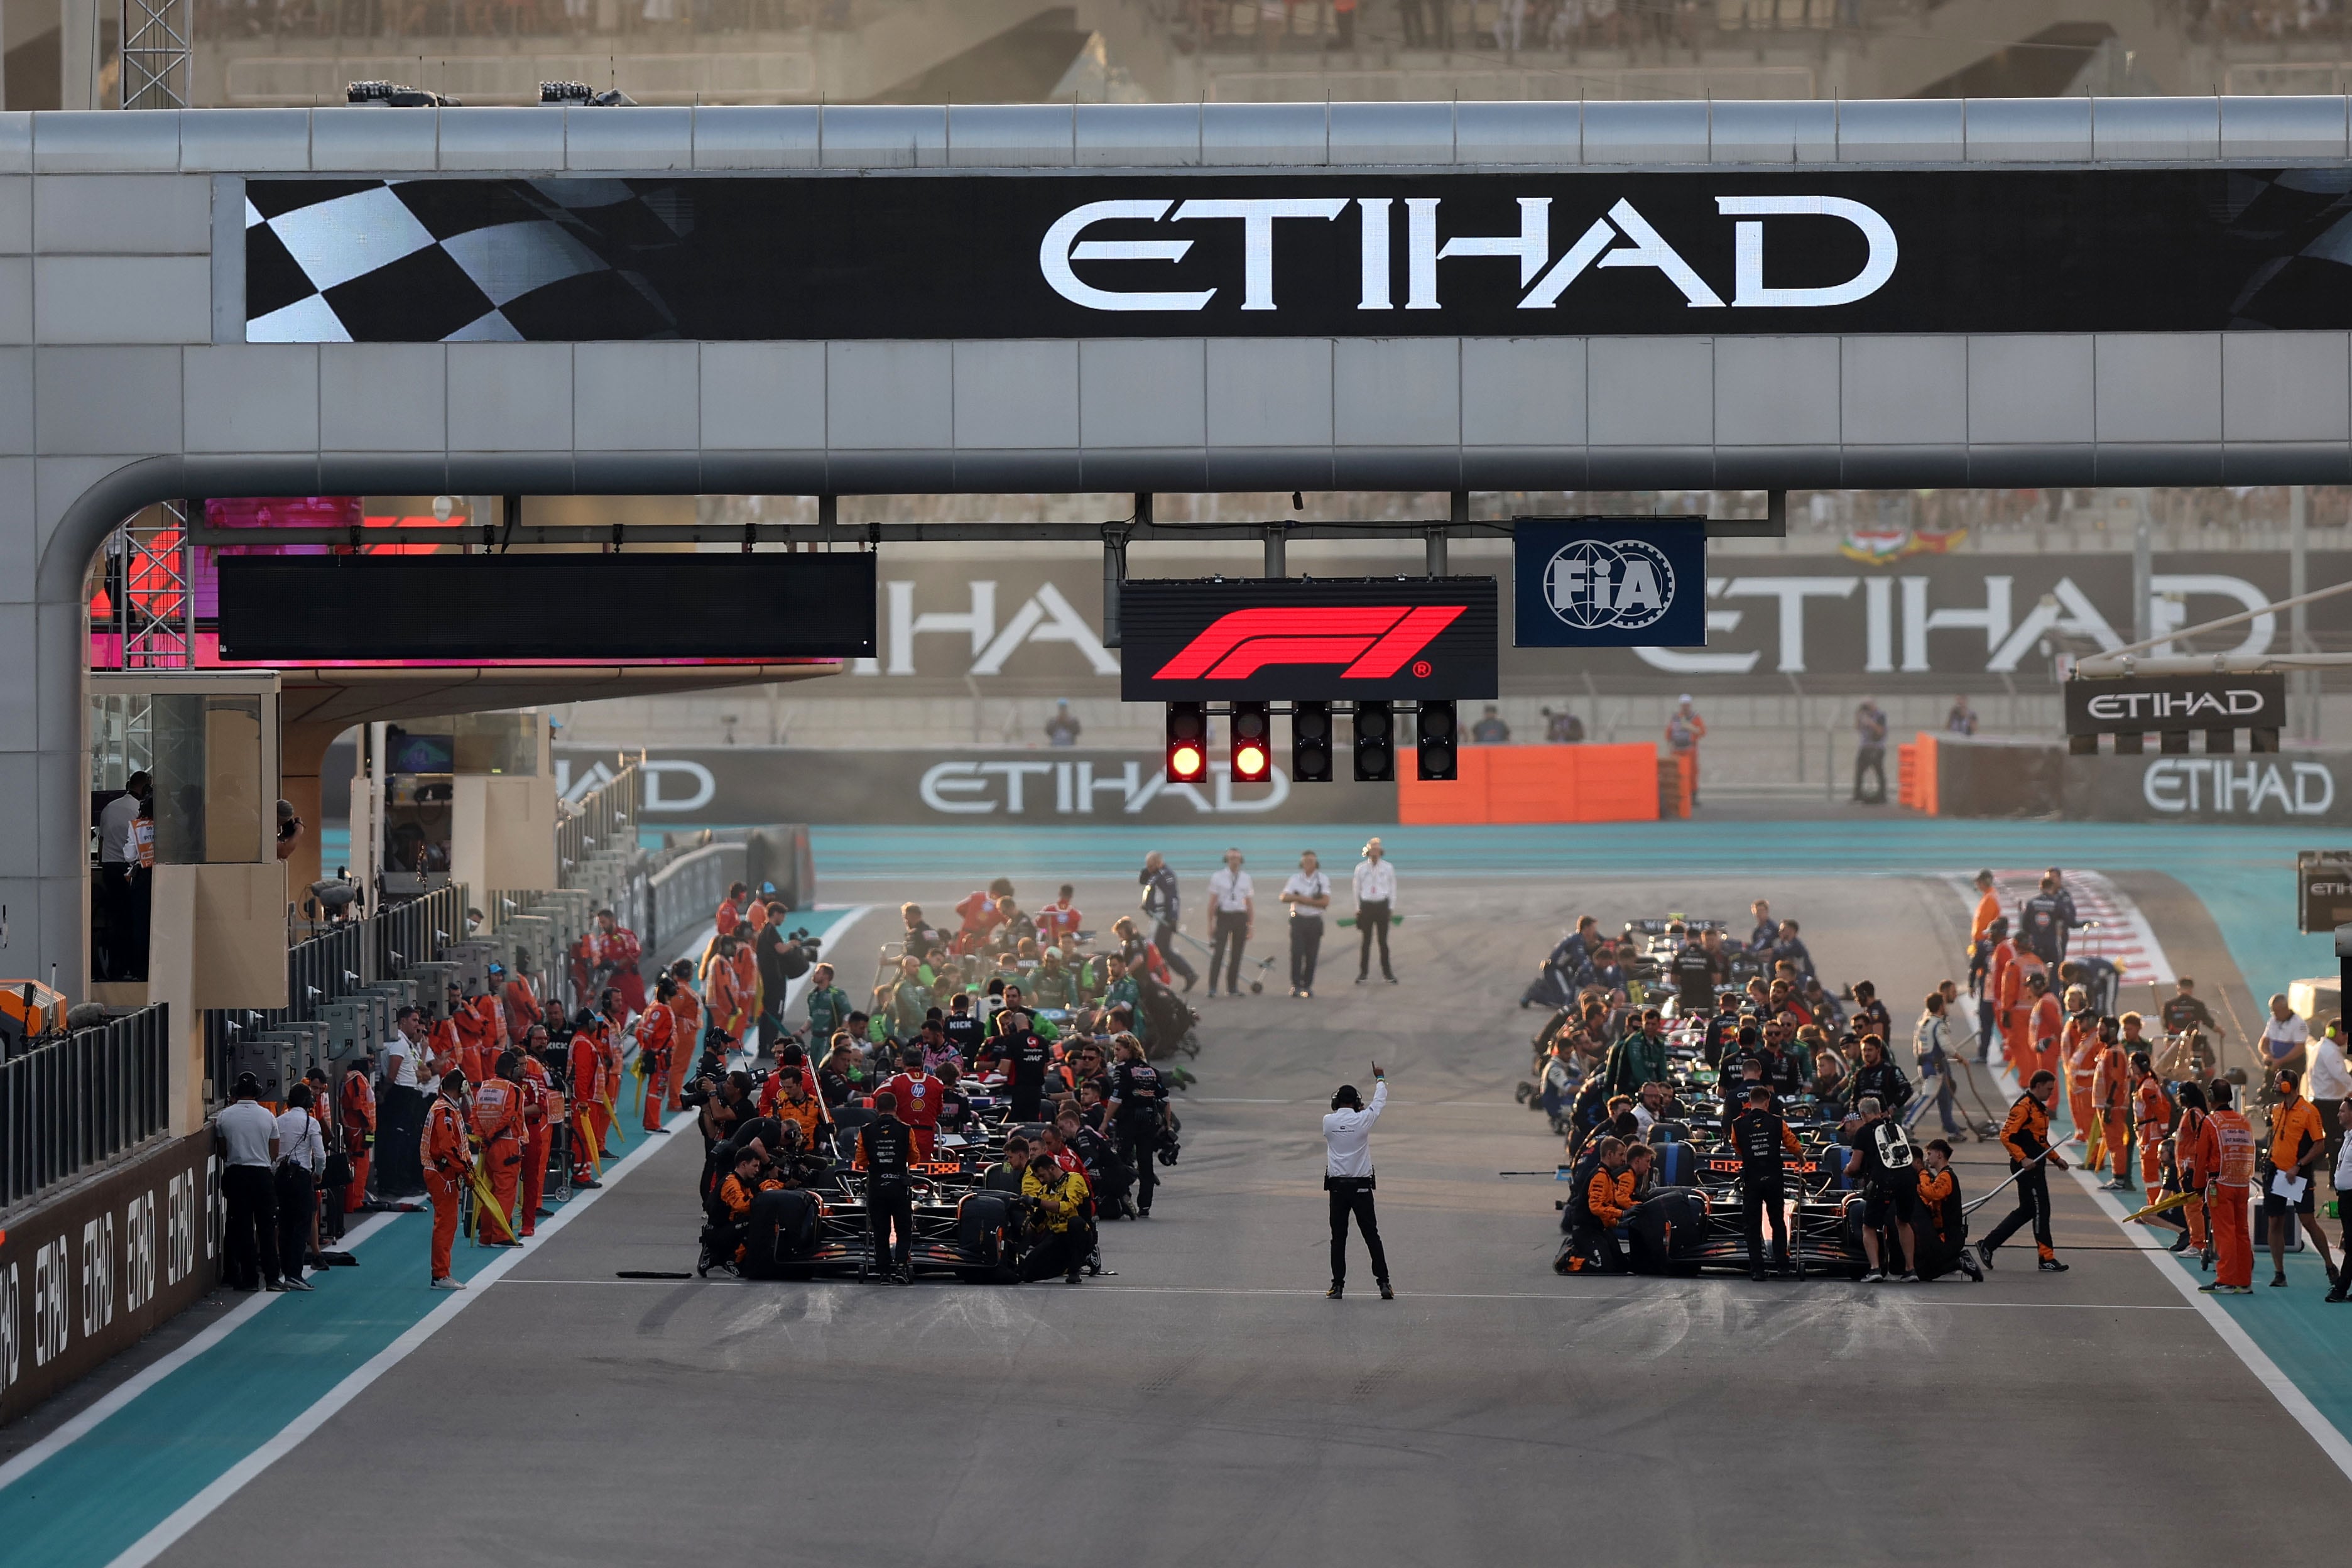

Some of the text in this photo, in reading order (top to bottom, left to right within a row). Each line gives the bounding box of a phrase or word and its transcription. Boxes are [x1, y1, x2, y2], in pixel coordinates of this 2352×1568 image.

[1039, 195, 1898, 311] ETIHAD
[2088, 690, 2265, 719] ETIHAD
[2143, 758, 2334, 815] ETIHAD
[949, 1020, 972, 1029] KICK
[83, 1211, 114, 1338] ETIHAD
[127, 1189, 155, 1313] ETIHAD
[168, 1167, 195, 1287] ETIHAD
[36, 1234, 68, 1368] ETIHAD
